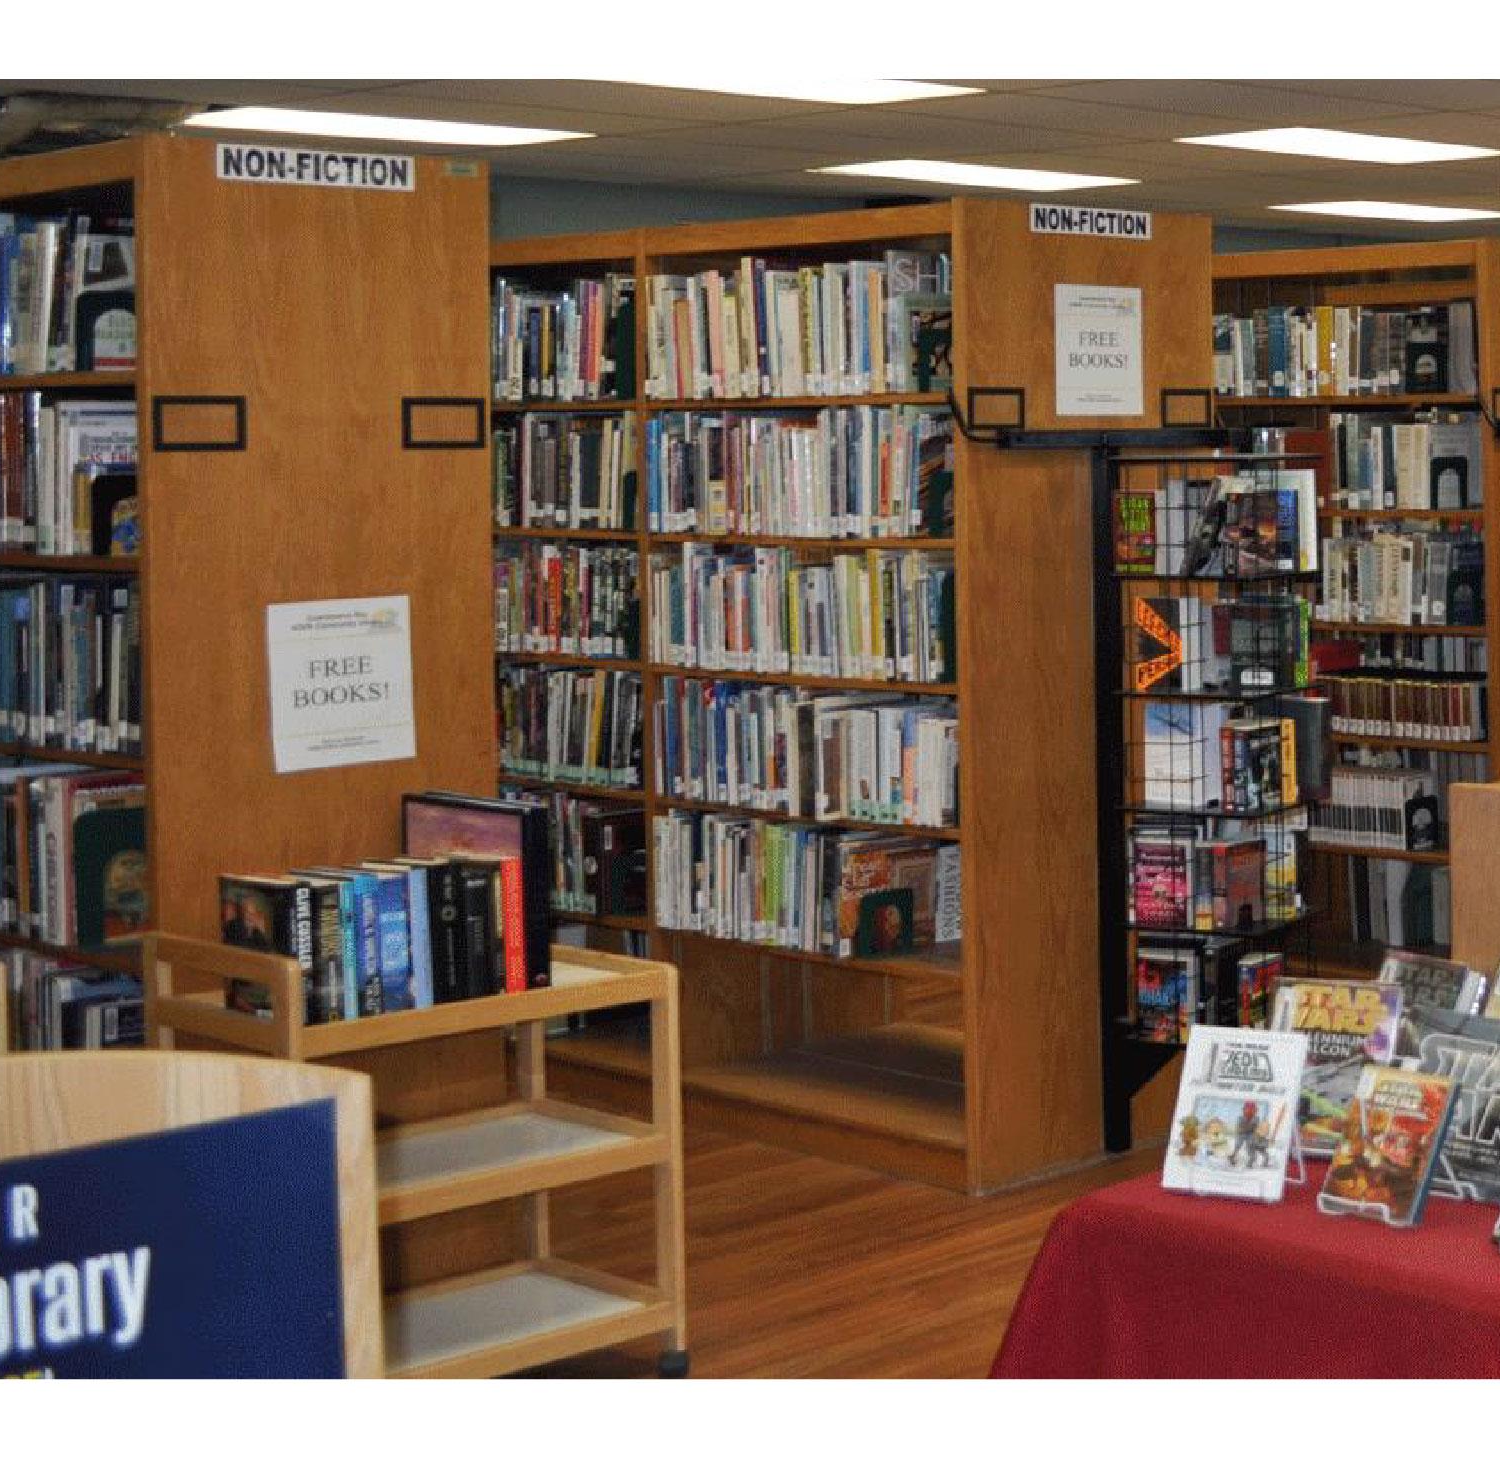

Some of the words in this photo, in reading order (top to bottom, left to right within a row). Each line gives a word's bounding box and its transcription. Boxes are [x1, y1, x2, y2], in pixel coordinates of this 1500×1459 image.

[222, 147, 408, 187] NON-FICTION
[1034, 207, 1147, 235] NON-FICTION
[1078, 331, 1120, 348] FREE
[1068, 352, 1129, 369] BOOKS!
[309, 655, 374, 679] FREE
[293, 682, 389, 709] BOOKS!
[296, 887, 311, 918] CLIVE
[297, 920, 312, 969] CUSSLER
